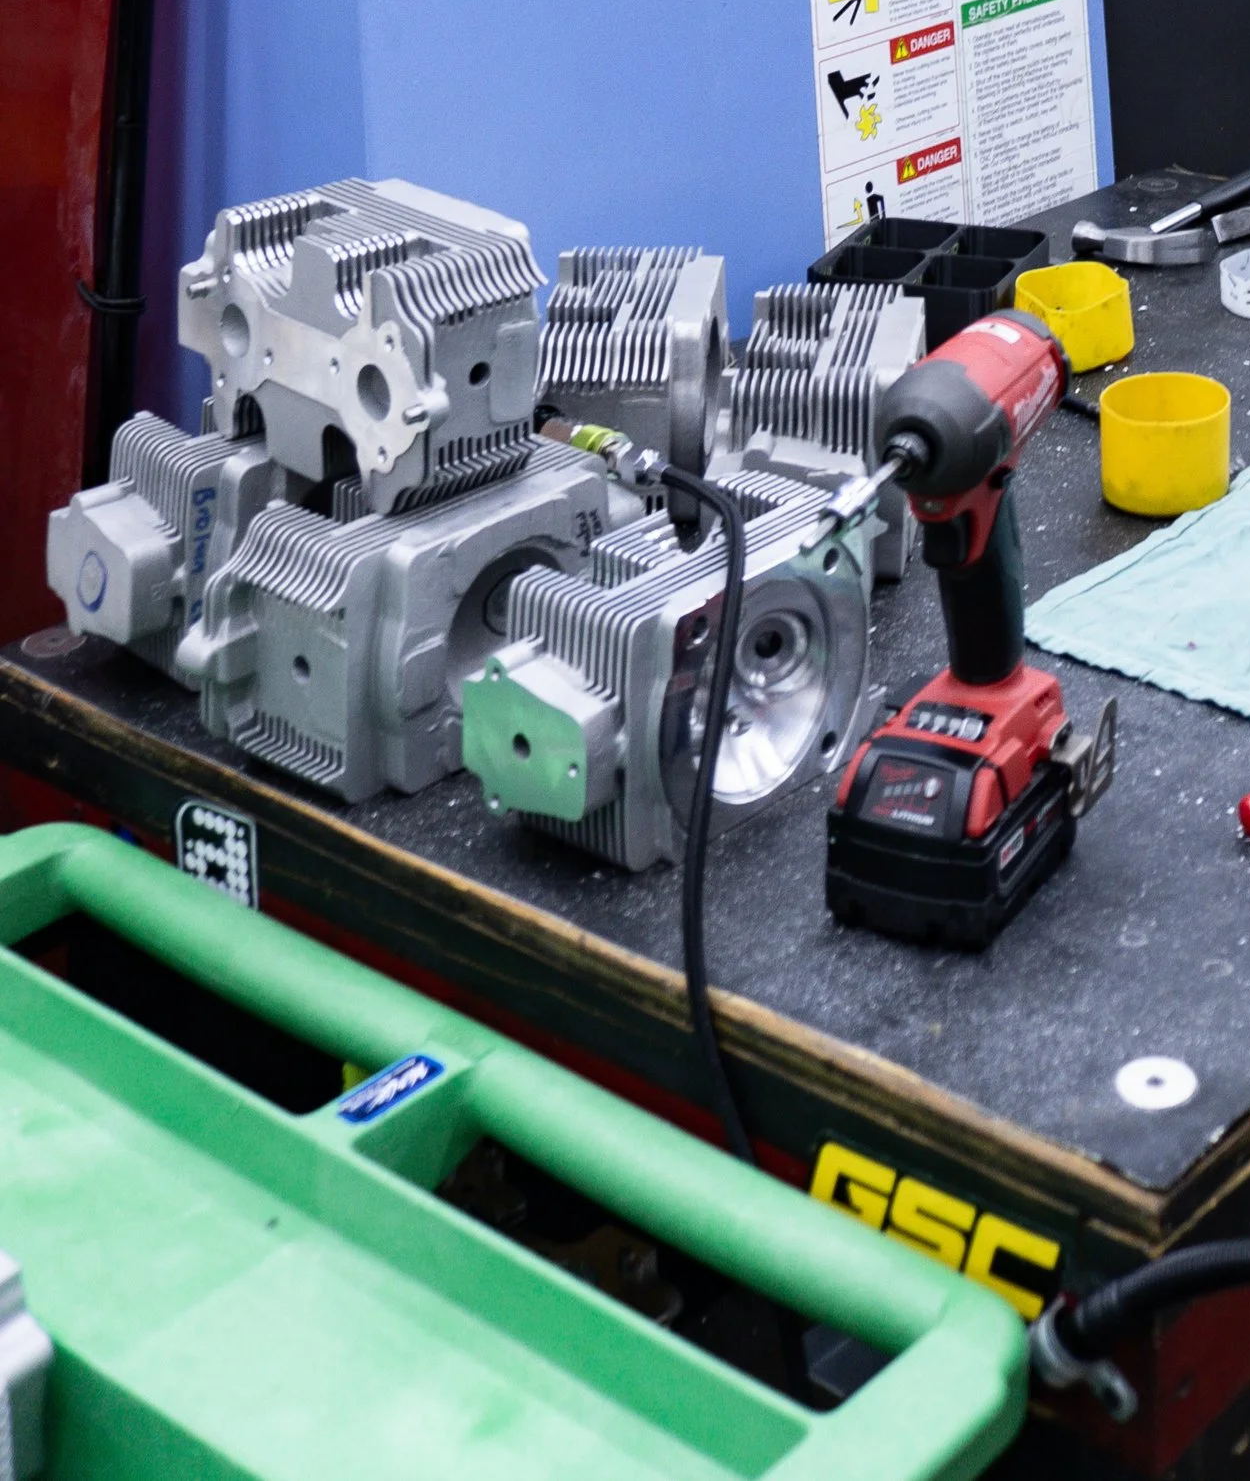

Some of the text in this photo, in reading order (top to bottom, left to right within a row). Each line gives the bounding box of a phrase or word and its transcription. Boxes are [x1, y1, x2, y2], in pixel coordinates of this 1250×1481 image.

[910, 30, 951, 52] DANGER
[917, 145, 958, 170] DANGER
[809, 1140, 1062, 1321] GSC
